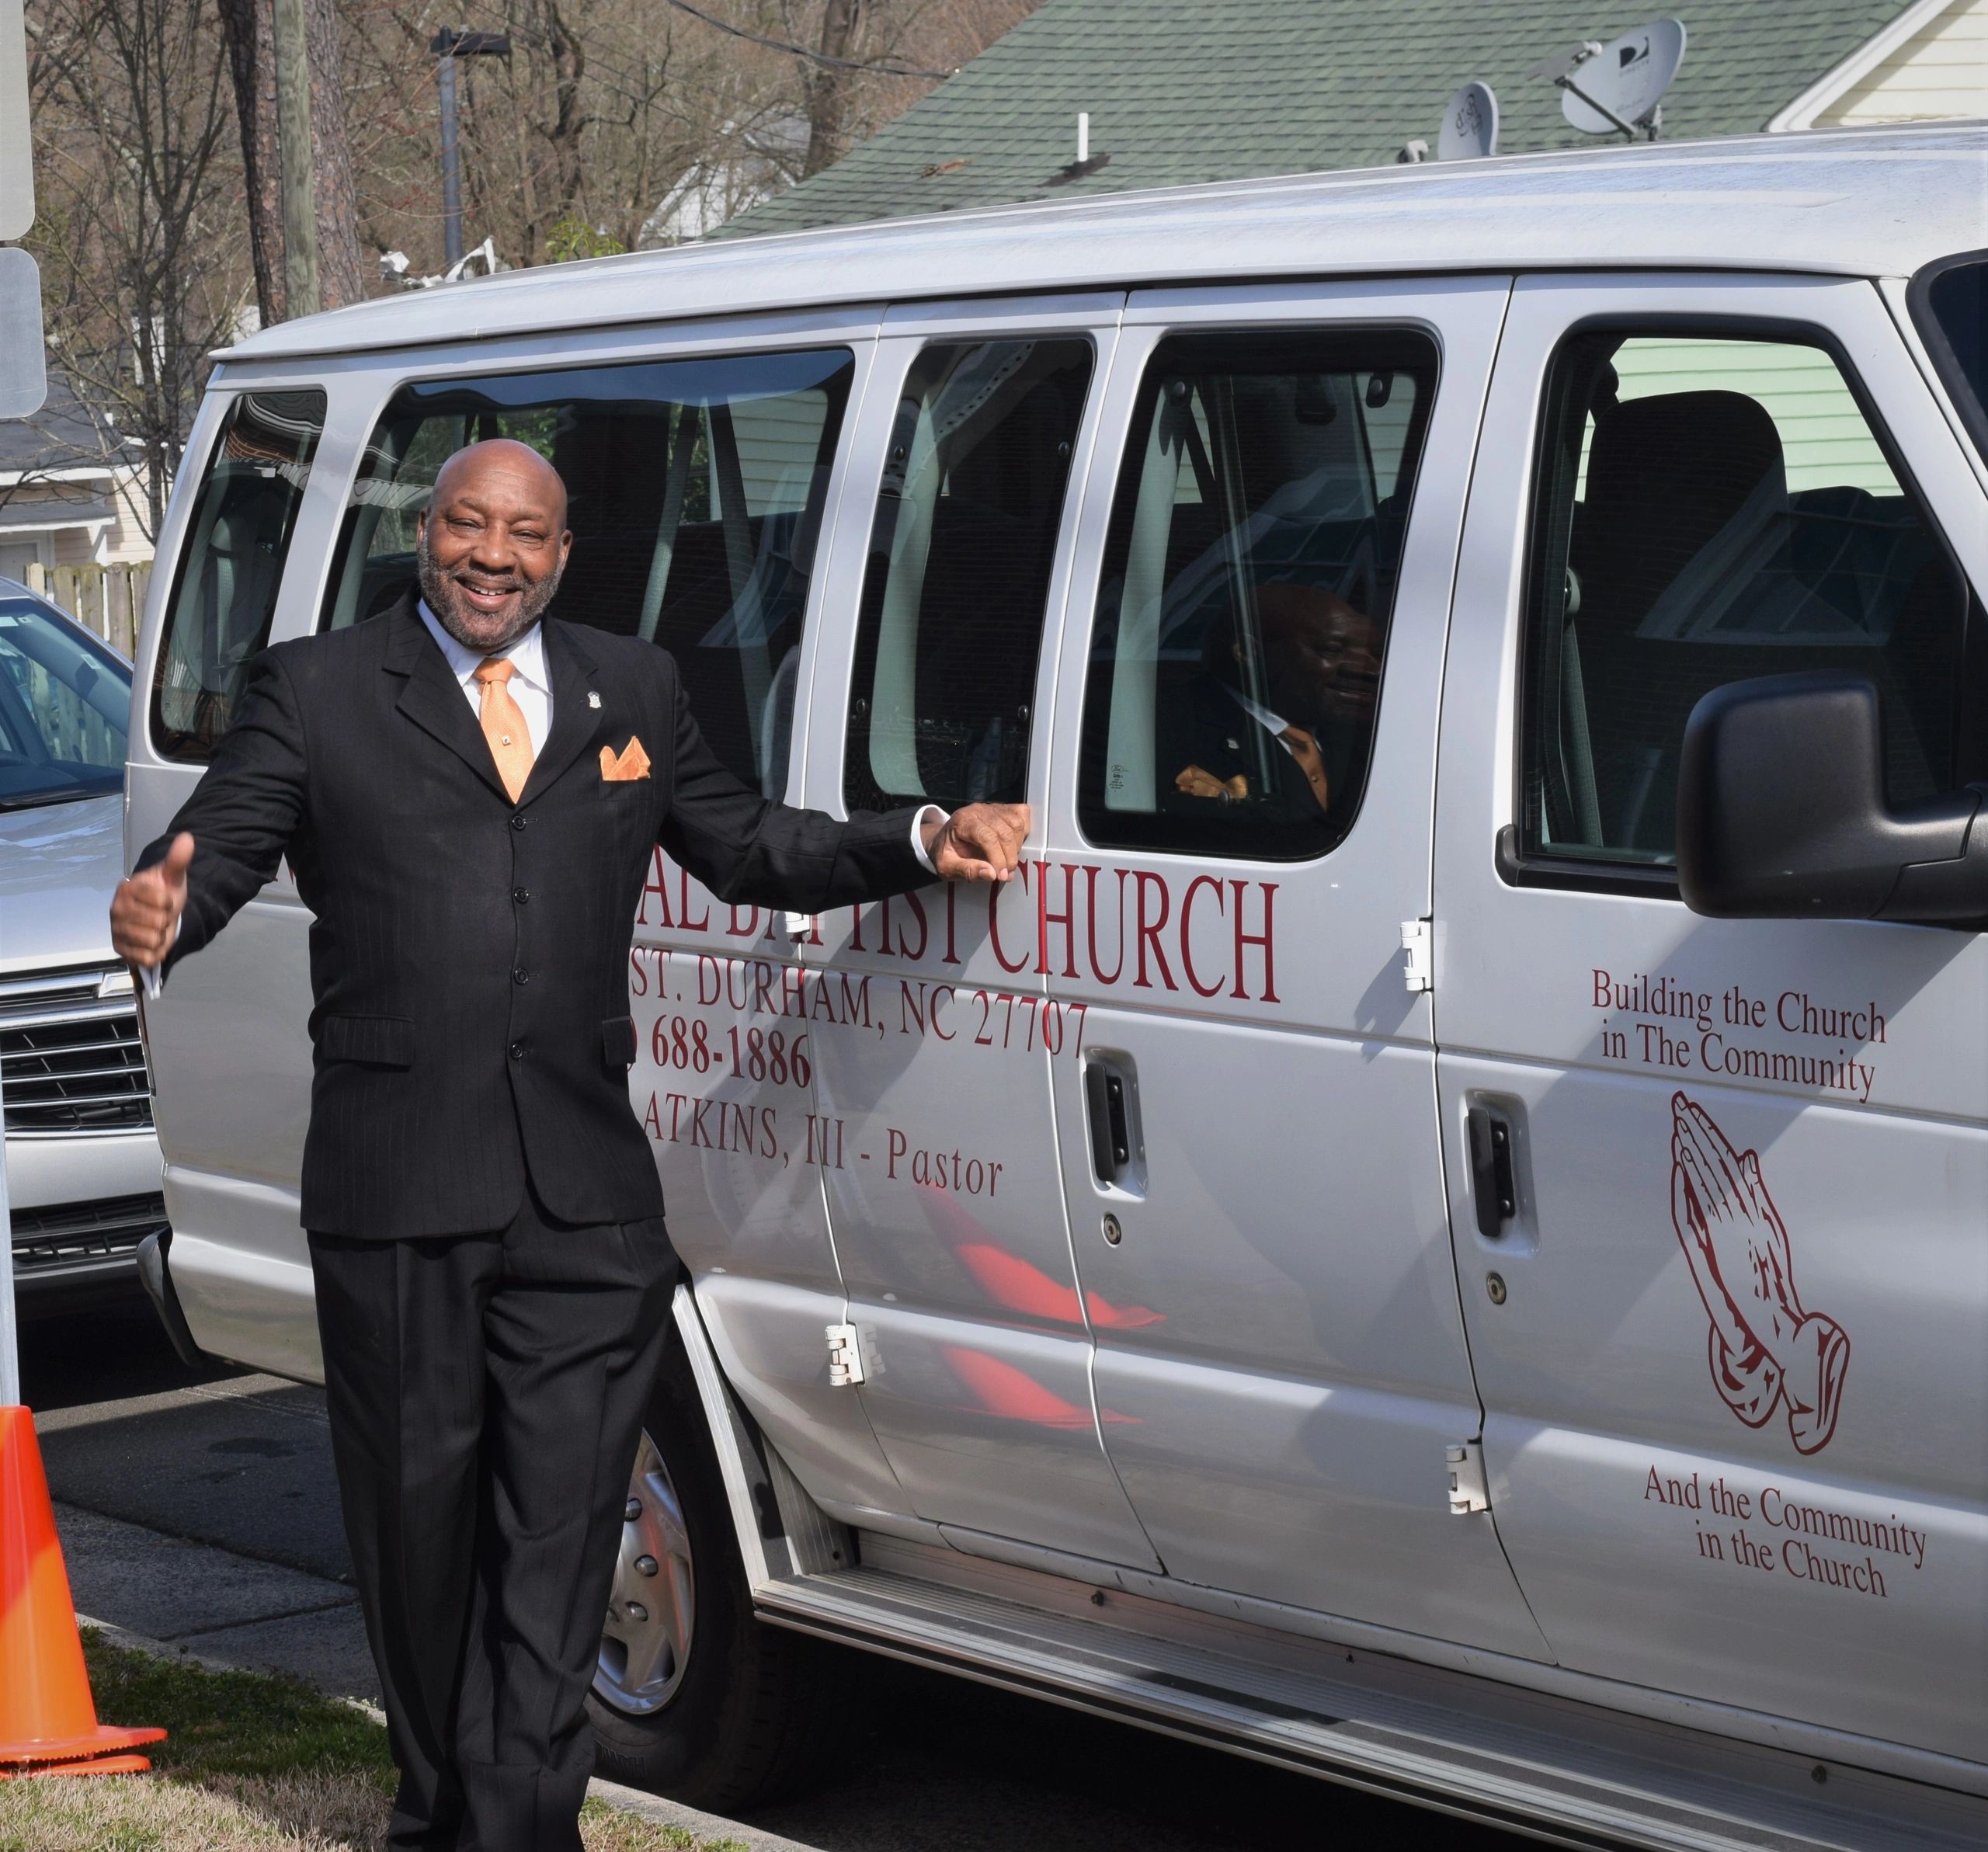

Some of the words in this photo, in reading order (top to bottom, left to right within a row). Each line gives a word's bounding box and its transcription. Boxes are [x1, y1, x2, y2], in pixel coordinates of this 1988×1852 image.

[636, 842, 710, 933] AL
[989, 858, 1281, 1004] CHURCH
[631, 944, 682, 1002] ST.
[697, 954, 885, 1041] DURHAM,
[899, 979, 957, 1041] NC
[971, 989, 1089, 1059] 27707
[1591, 968, 1713, 1033] Building
[1722, 985, 1767, 1028] the
[1776, 991, 1887, 1044] Church
[652, 1014, 811, 1089] 688-1886
[1601, 1018, 1628, 1060] in
[1635, 1023, 1691, 1068] The
[1700, 1032, 1876, 1104] Community
[643, 1089, 790, 1169] ATKINS,
[805, 1114, 846, 1169] III
[887, 1128, 1003, 1197] Pastor
[1643, 1464, 1703, 1510] And
[1708, 1477, 1752, 1520] the
[1760, 1487, 1927, 1570] Community
[1695, 1519, 1726, 1561] in
[1730, 1528, 1775, 1572] the
[1781, 1538, 1889, 1598] Church
